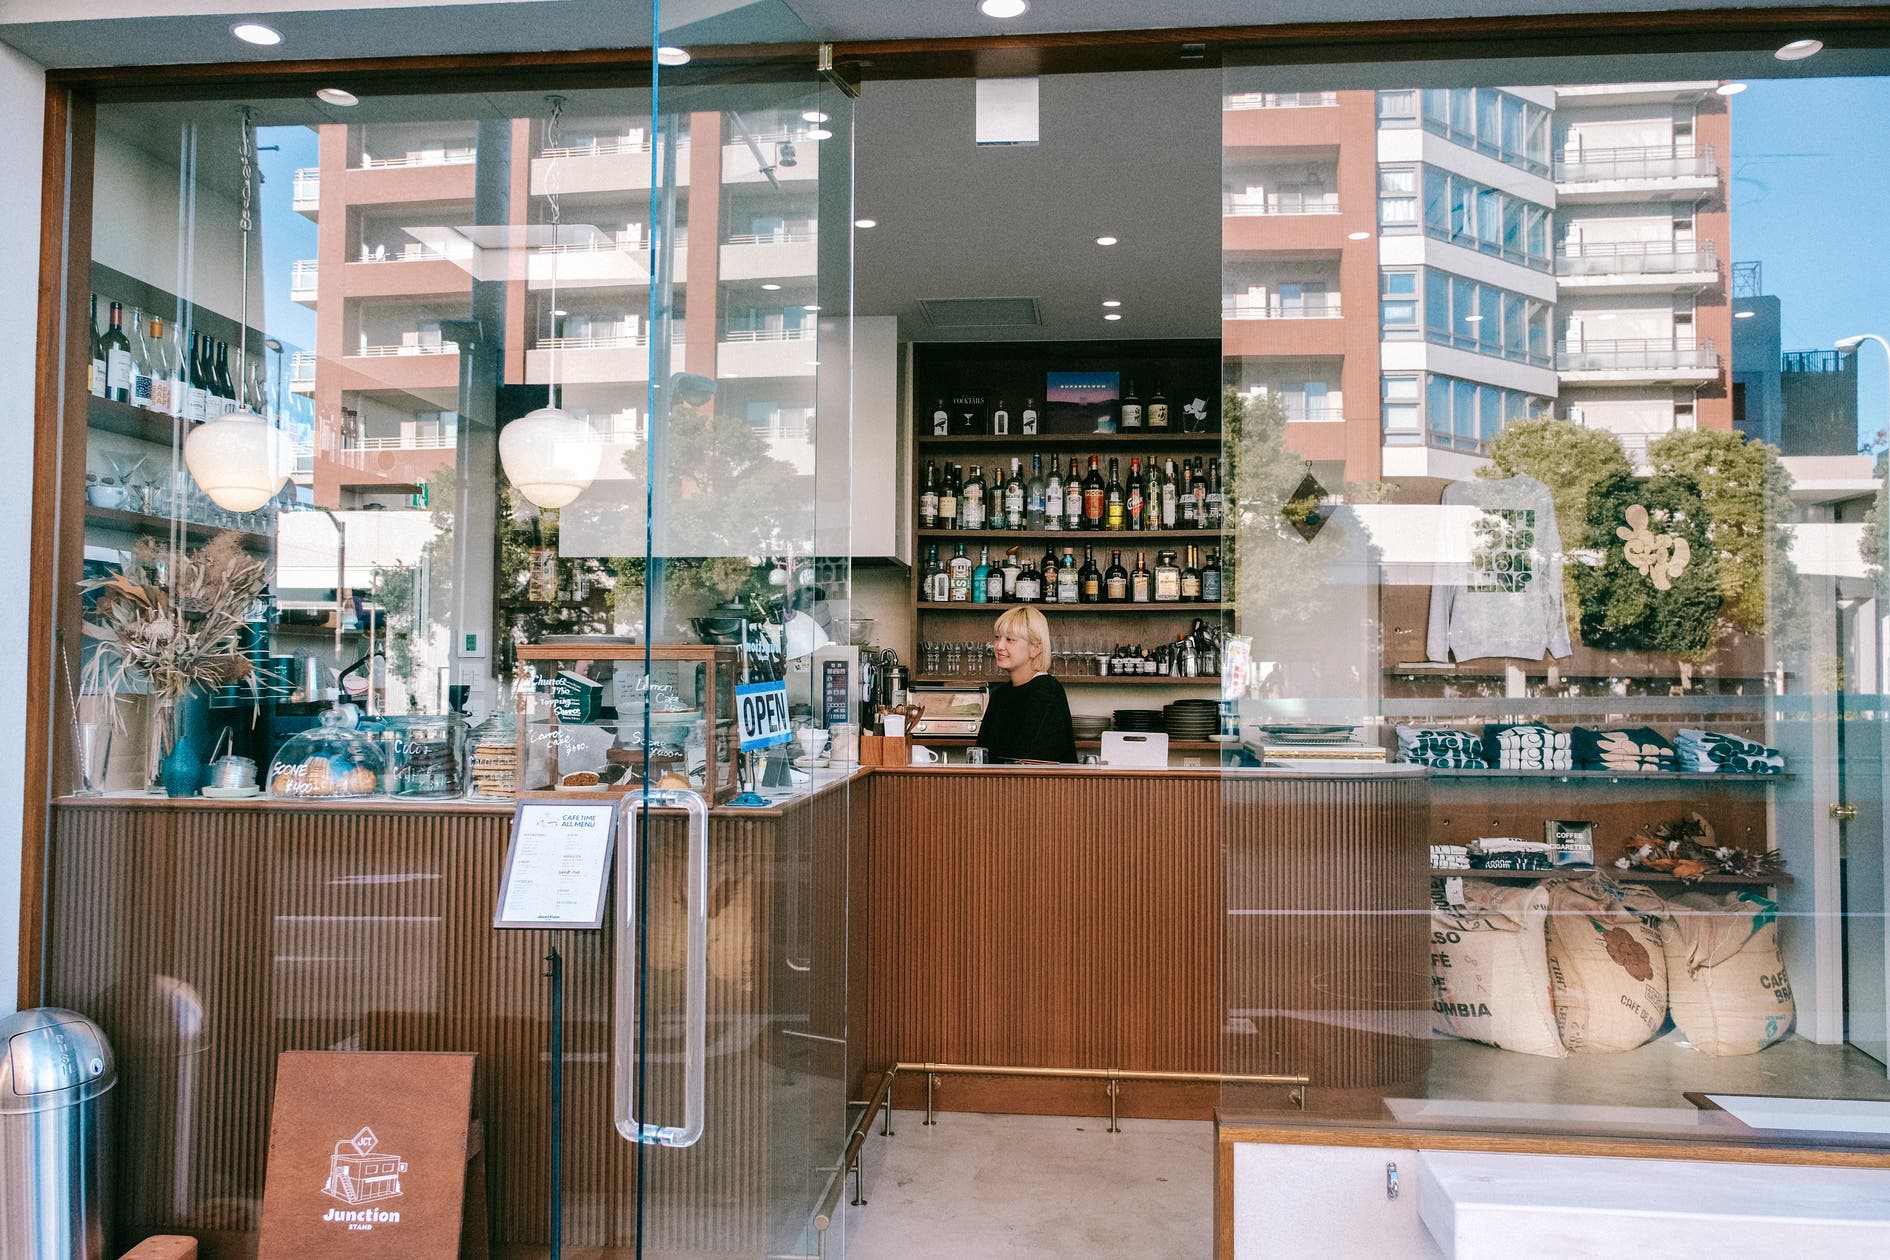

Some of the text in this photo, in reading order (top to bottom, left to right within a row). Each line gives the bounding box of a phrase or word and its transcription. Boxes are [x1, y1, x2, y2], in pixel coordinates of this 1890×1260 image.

[743, 692, 787, 737] OPEN
[272, 761, 309, 777] SCONE
[357, 1137, 372, 1146] JCT
[323, 1207, 400, 1223] Junction
